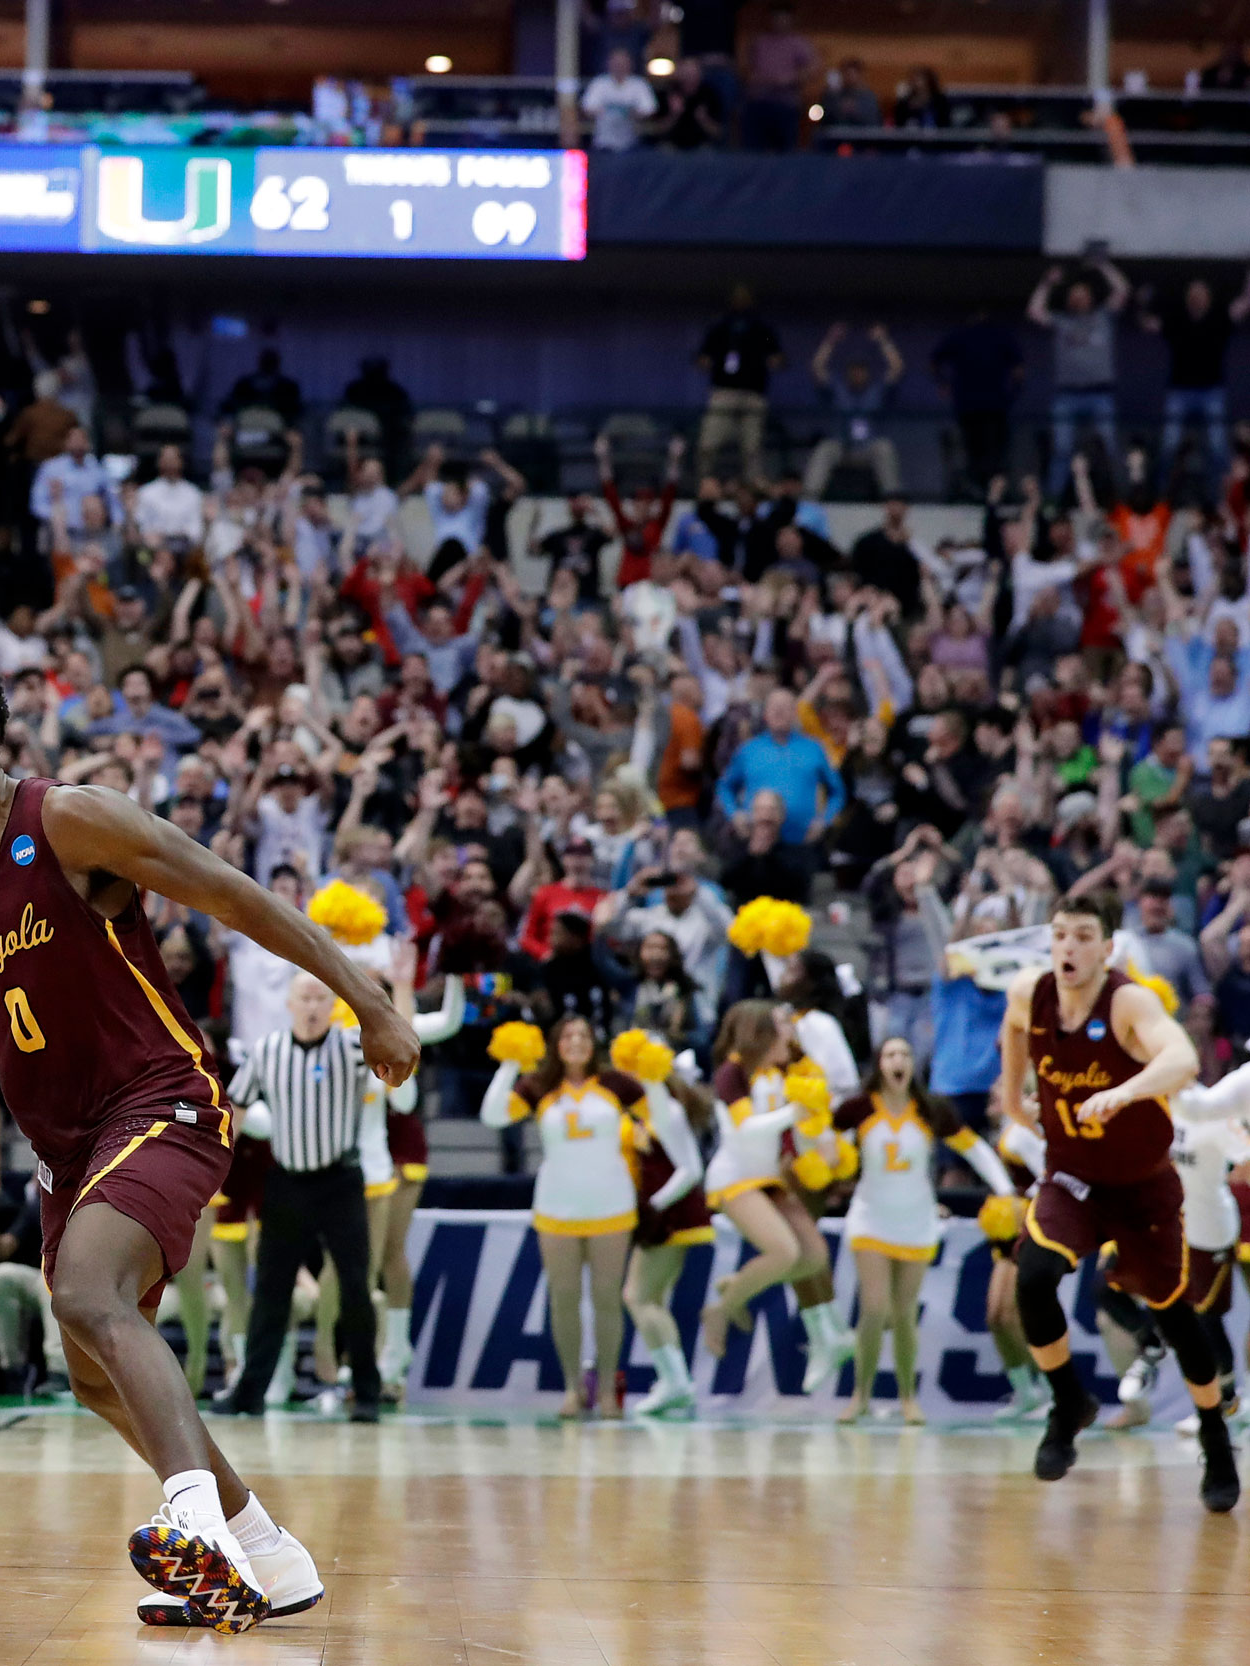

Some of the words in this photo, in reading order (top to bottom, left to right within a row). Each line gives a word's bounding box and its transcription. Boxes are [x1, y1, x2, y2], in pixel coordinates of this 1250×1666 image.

[97, 157, 231, 245] U
[250, 176, 330, 231] 62
[389, 199, 413, 241] 1
[15, 845, 35, 861] NCAA
[4, 986, 47, 1054] 0
[565, 1112, 594, 1140] L
[883, 1141, 912, 1171] L
